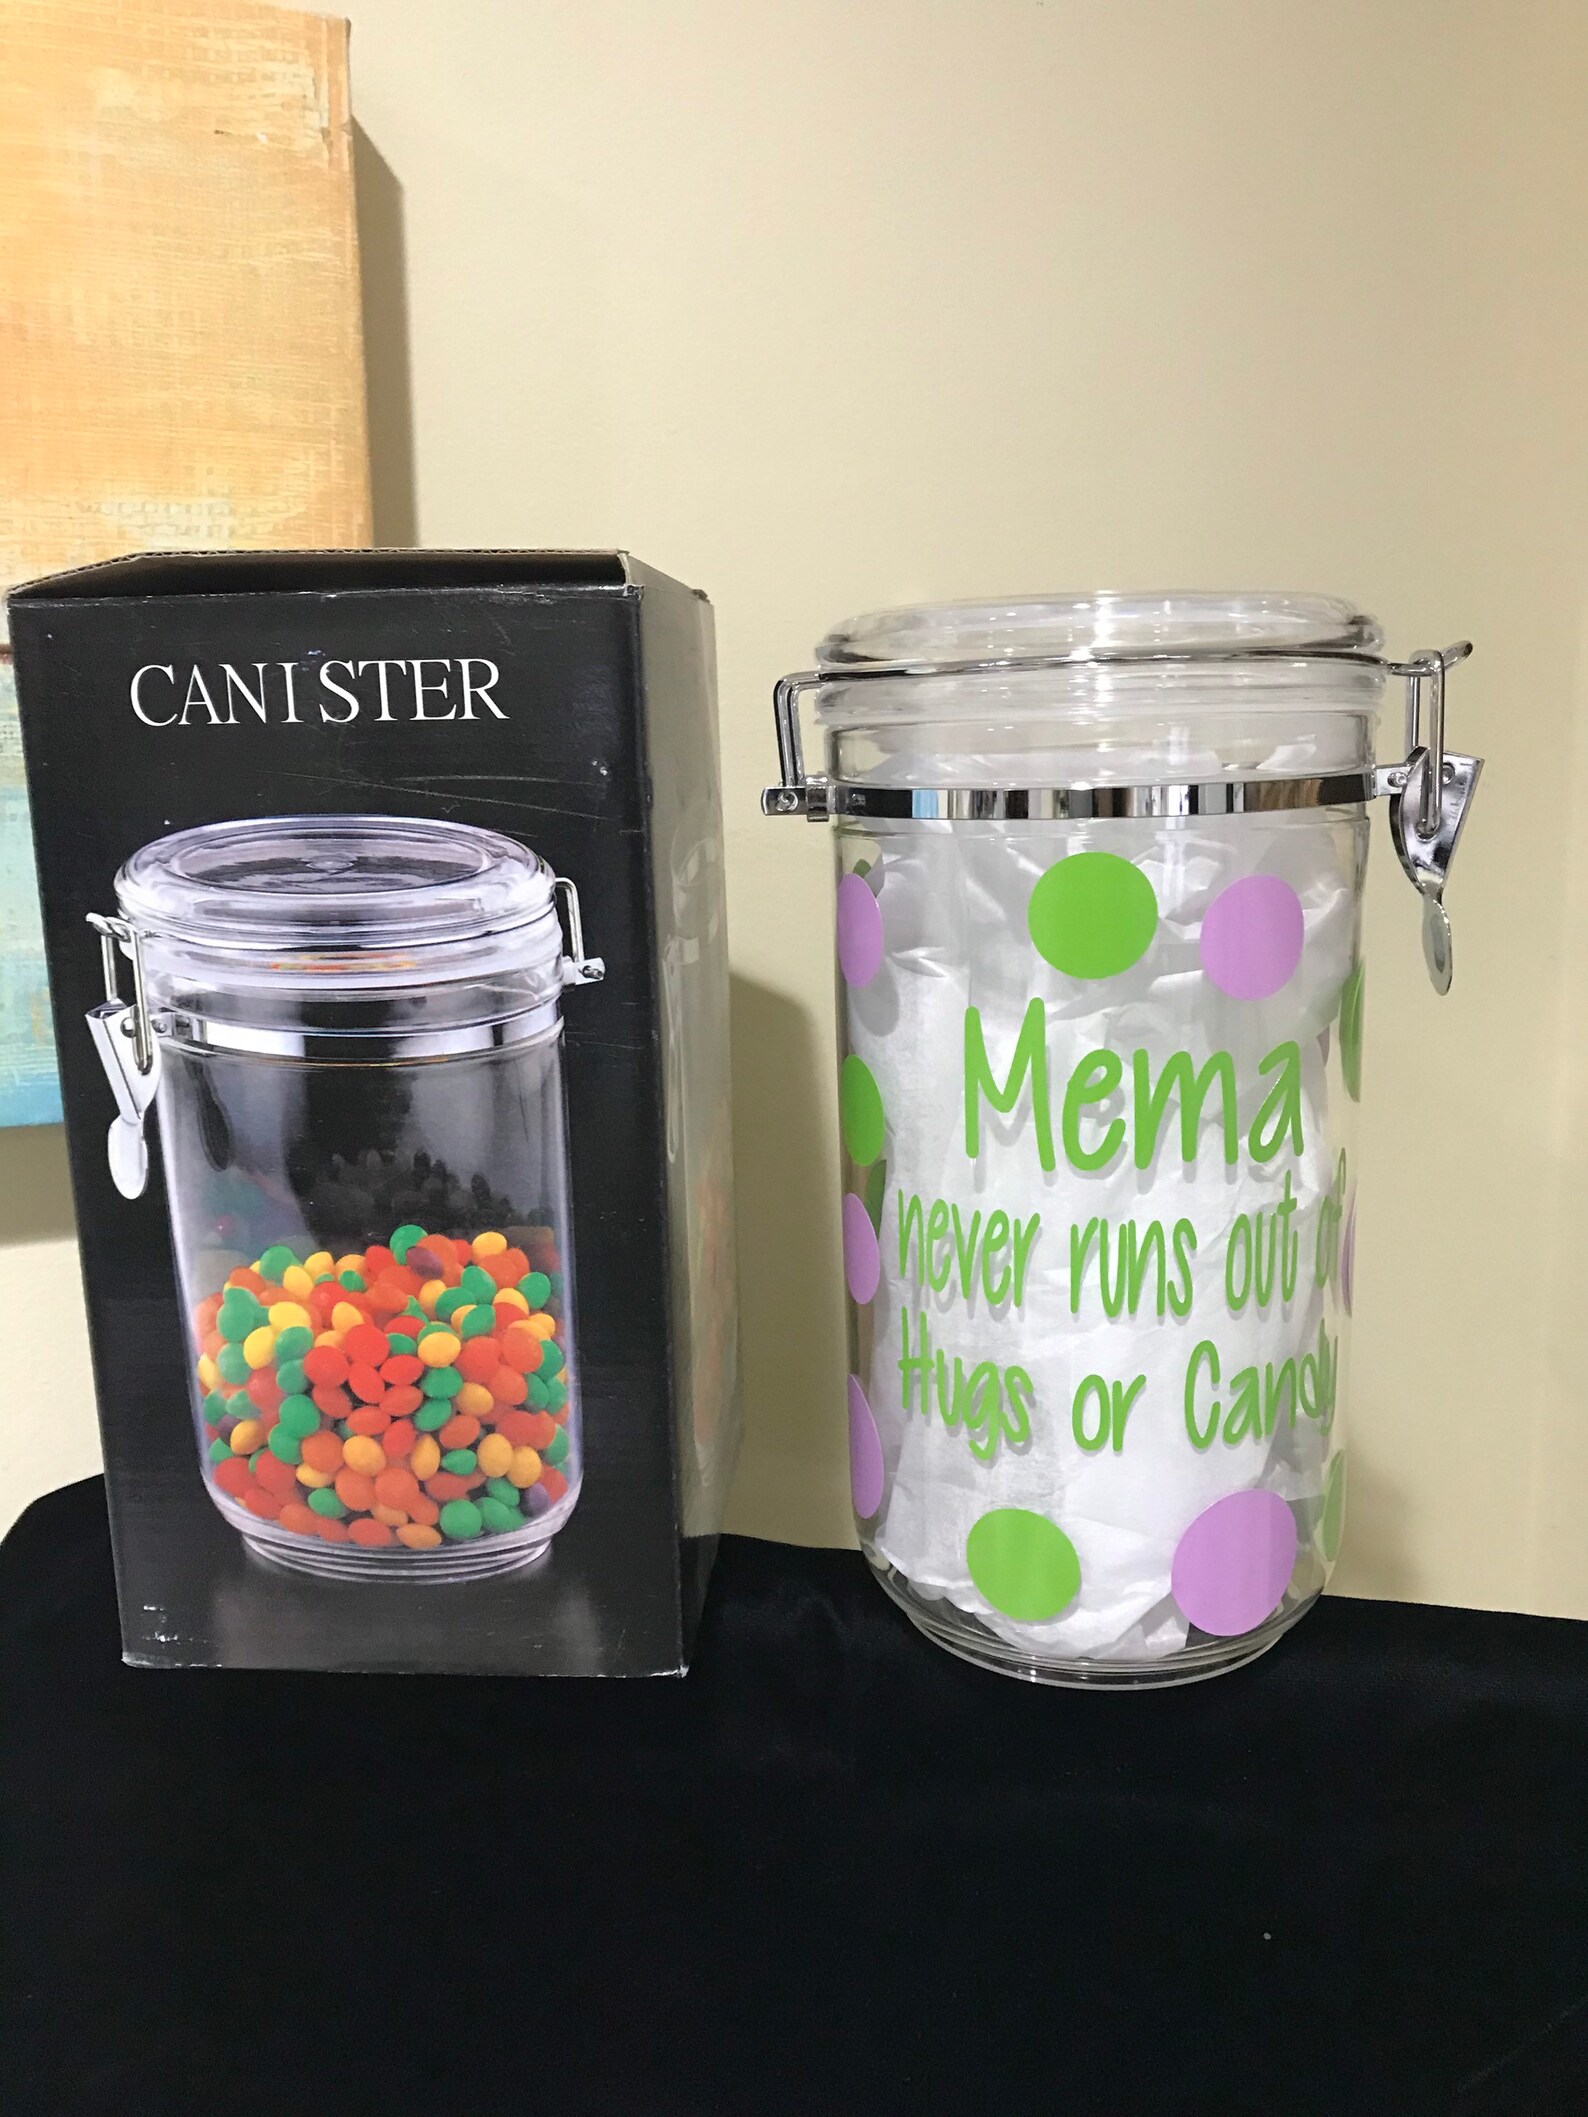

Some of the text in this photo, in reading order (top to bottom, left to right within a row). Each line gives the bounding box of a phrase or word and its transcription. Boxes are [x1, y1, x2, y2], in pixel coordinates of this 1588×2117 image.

[130, 658, 511, 727] CANISTER
[964, 997, 1304, 1172] Mema
[898, 1188, 1041, 1308] never
[1070, 1216, 1198, 1318] runs
[1225, 1168, 1298, 1311] out
[898, 1306, 1339, 1461] Hugs or Candy
